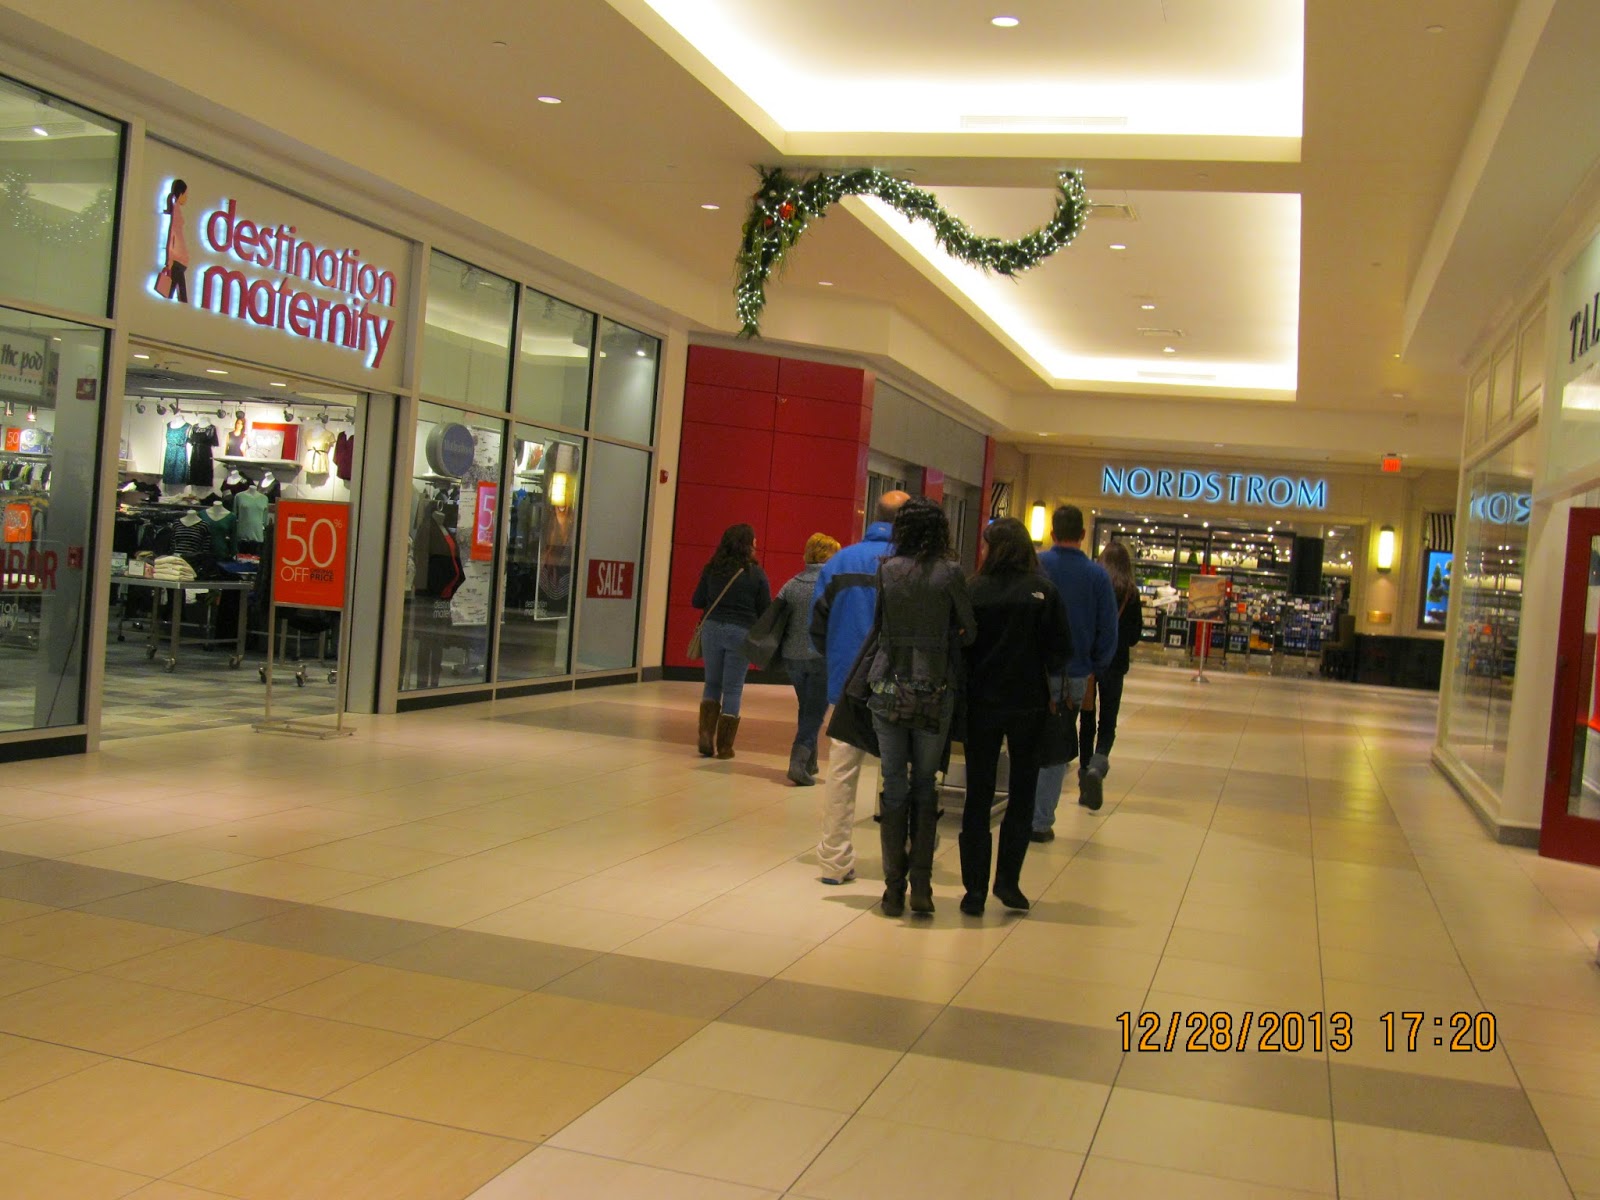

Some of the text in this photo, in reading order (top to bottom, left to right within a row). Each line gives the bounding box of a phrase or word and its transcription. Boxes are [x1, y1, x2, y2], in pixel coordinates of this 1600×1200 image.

[206, 199, 398, 308] destination
[200, 264, 396, 369] maternity
[1102, 466, 1326, 509] NORDSTROM
[281, 565, 310, 582] OFF
[597, 561, 626, 596] SALE
